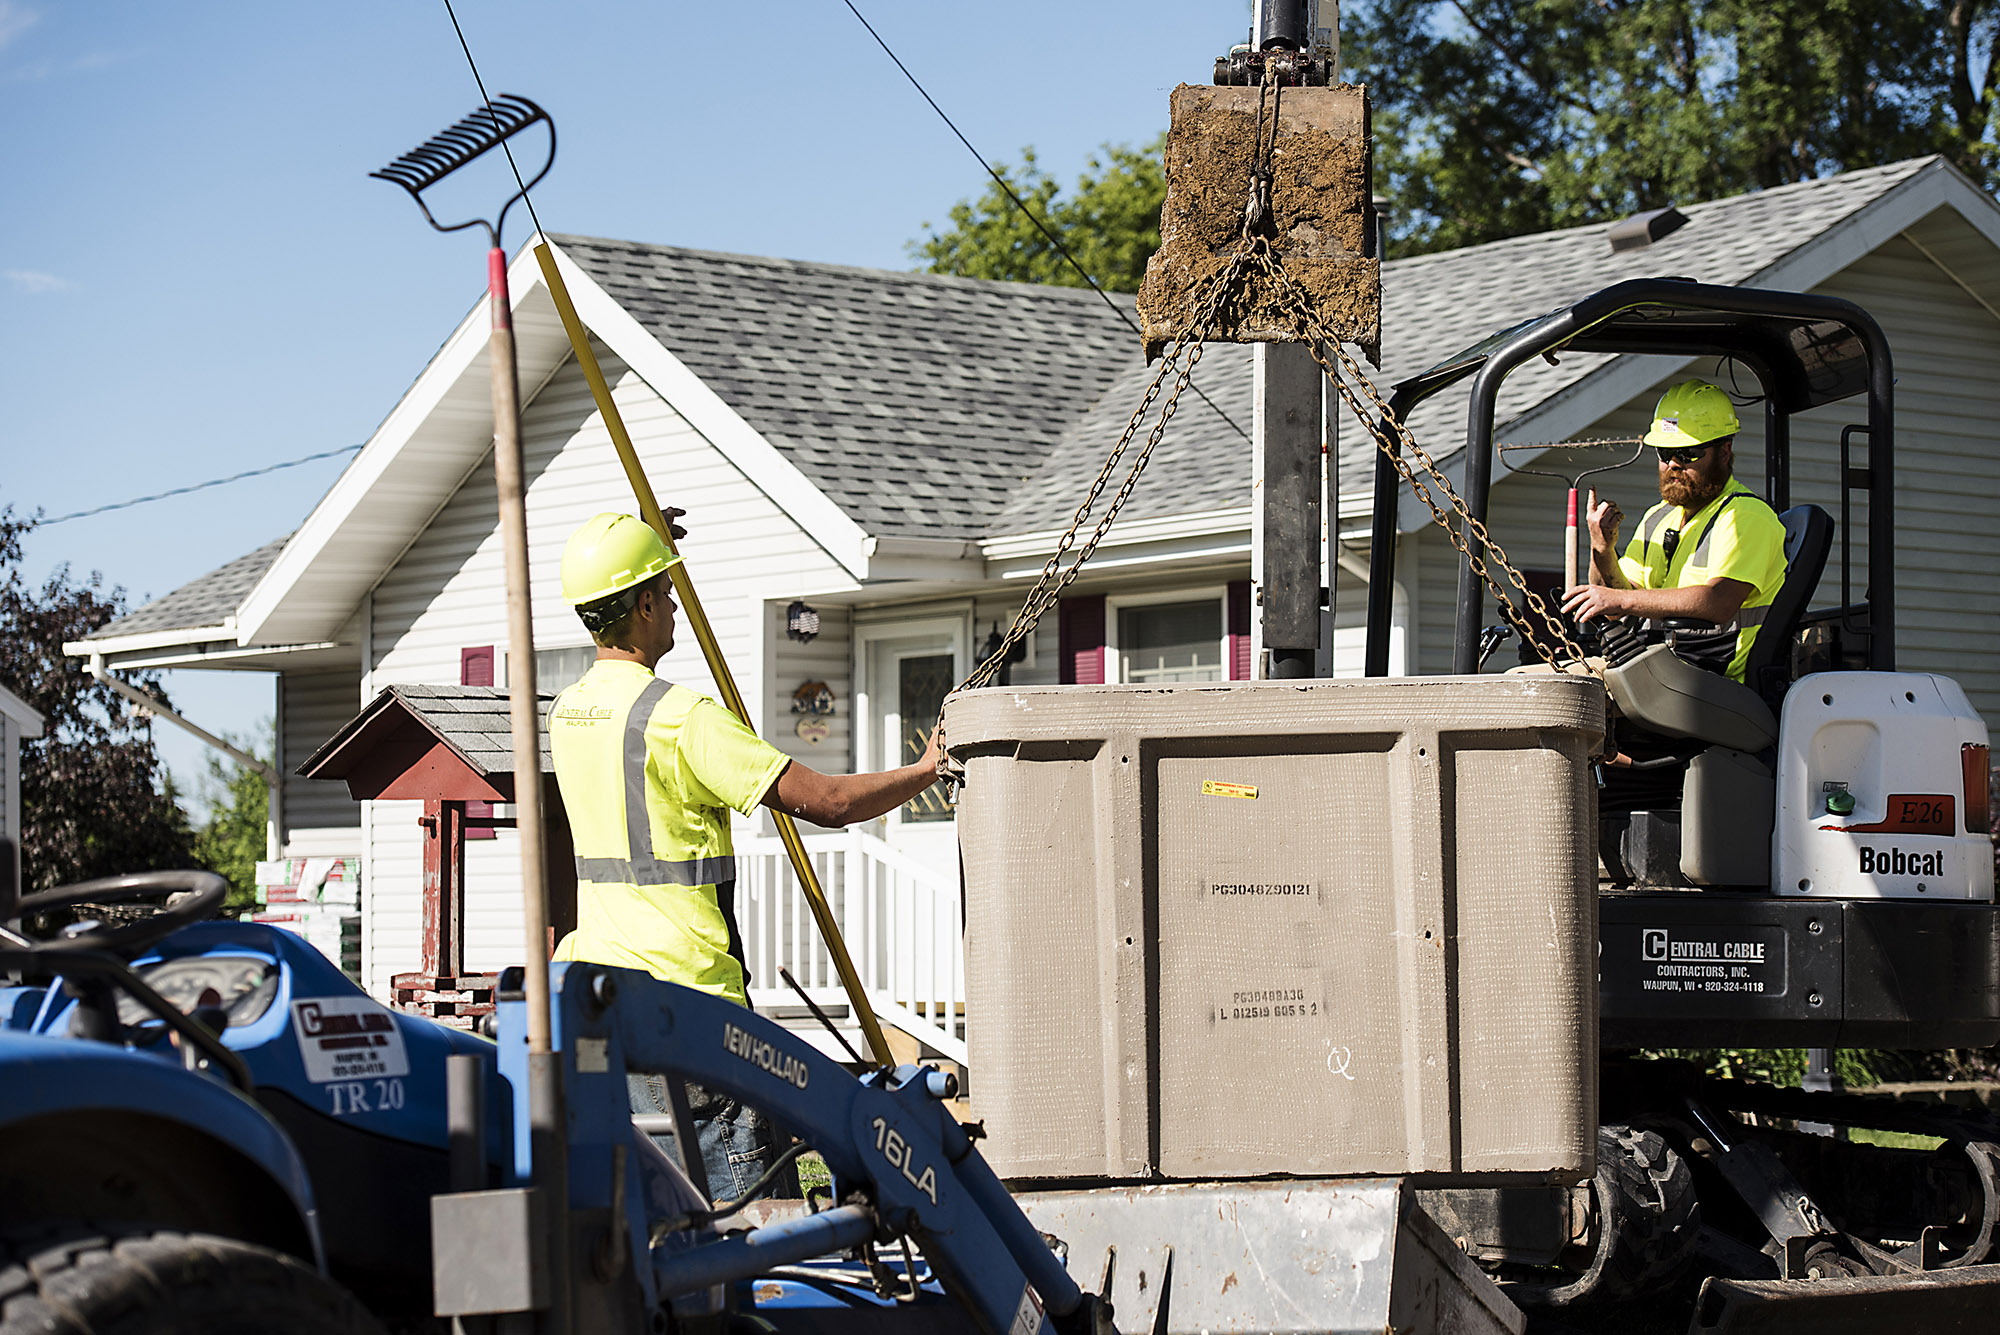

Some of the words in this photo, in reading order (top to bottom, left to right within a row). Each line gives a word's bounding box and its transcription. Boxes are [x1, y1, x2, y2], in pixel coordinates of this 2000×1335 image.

[1900, 801, 1943, 824] E26
[1860, 846, 1944, 877] Bobcat
[1723, 942, 1765, 960] CABLE
[1656, 964, 1728, 980] CONTRACTORS,
[1731, 966, 1750, 978] INC.
[1643, 980, 1681, 992] WAUPUN,
[1684, 981, 1695, 991] WI
[1705, 981, 1764, 993] 920-324-4118
[1220, 1008, 1228, 1020] L
[724, 1024, 753, 1061] NEW
[752, 1037, 808, 1089] HOLLAND
[326, 1083, 371, 1115] TR
[375, 1080, 405, 1110] 20
[873, 1117, 938, 1206] 16LA
